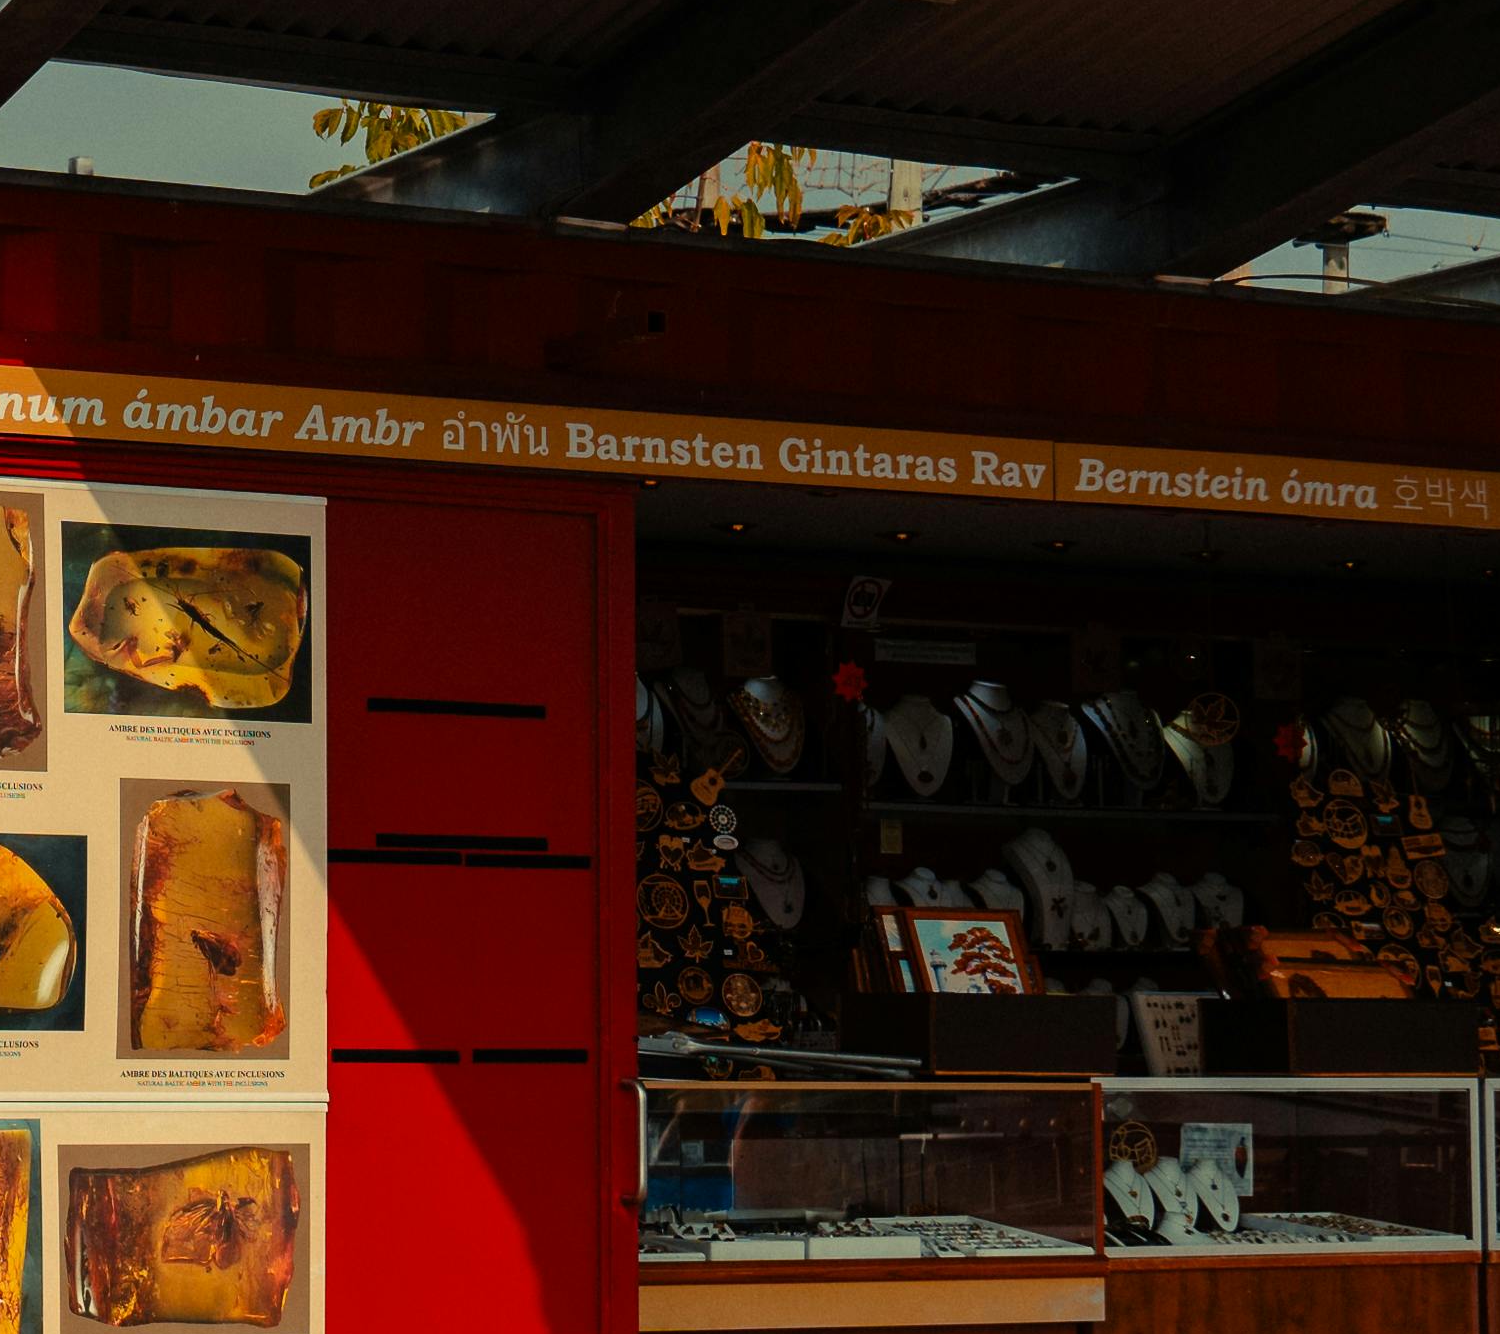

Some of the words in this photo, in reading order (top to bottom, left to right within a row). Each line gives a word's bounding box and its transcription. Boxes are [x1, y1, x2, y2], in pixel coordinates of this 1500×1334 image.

[123, 388, 283, 438] ámbar
[295, 404, 425, 446] Ambr
[442, 410, 549, 456] อำพัน
[565, 422, 763, 471] Barnsten
[779, 437, 957, 484] Gintaras
[971, 450, 1046, 489] Rav
[1075, 458, 1269, 503] Bernstein
[1281, 467, 1378, 511] ómra
[1393, 474, 1488, 521] 호박색
[109, 725, 139, 734] AMBRE
[139, 726, 155, 734] DES
[157, 727, 201, 736] BALTIQUES
[201, 728, 223, 737] AVEC
[224, 729, 271, 738] INCLUSIONS
